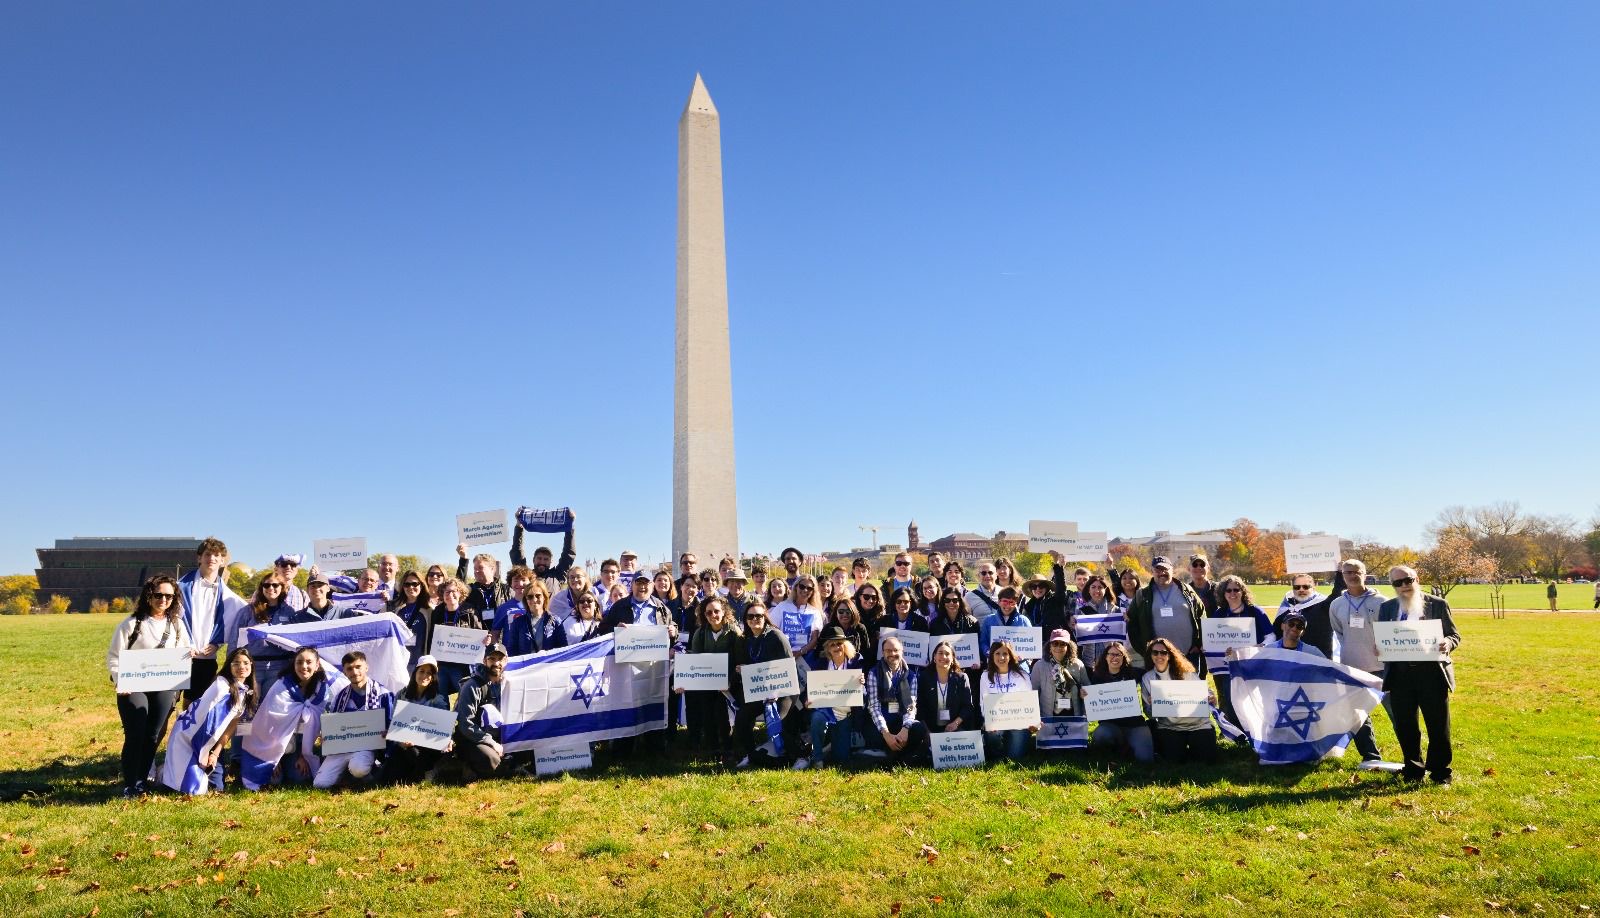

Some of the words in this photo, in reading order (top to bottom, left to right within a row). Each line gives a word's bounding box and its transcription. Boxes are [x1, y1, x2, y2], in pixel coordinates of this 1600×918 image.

[1216, 631, 1239, 639] ישראל
[1393, 637, 1421, 645] ישראל
[903, 651, 922, 659] srael
[120, 670, 189, 679] #BringThemHome
[750, 675, 764, 683] We
[765, 671, 788, 681] stand
[749, 685, 768, 694] with
[769, 681, 793, 691] Israel
[808, 688, 861, 696] #BringThemHome
[1098, 697, 1122, 706] ישראל
[392, 720, 450, 738] #BringThemHome
[939, 744, 953, 752] We
[953, 743, 976, 751] stand
[537, 753, 590, 763] #BringThemHome
[938, 755, 957, 763] with
[957, 753, 979, 761] Israel
